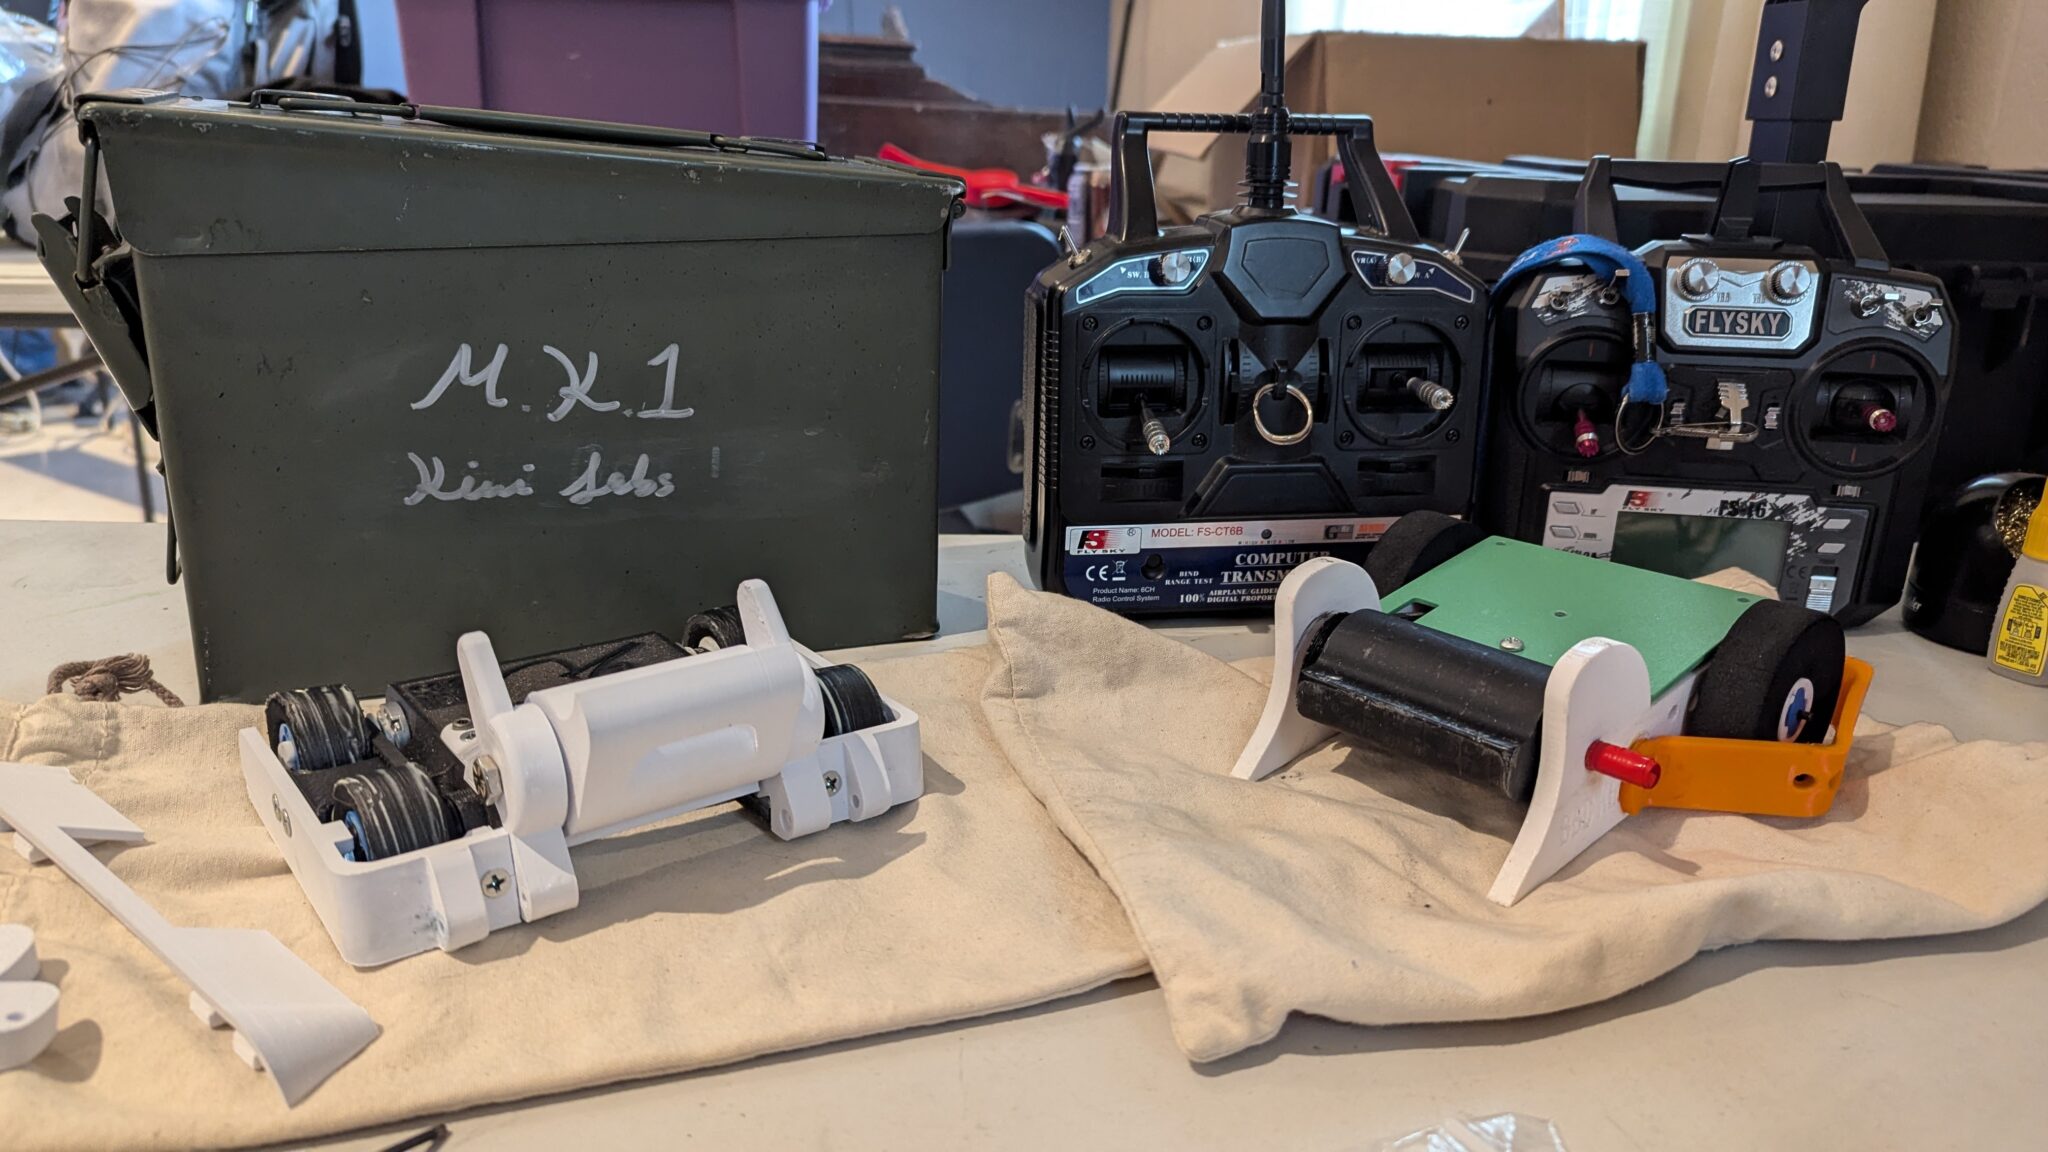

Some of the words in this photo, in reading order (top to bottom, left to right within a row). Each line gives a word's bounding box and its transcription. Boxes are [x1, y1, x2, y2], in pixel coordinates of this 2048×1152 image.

[1695, 310, 1782, 336] FLYSKY
[1151, 528, 1194, 538] MODEL:
[1197, 526, 1244, 537] FS-CT6B
[1220, 569, 1292, 583] TRANSM
